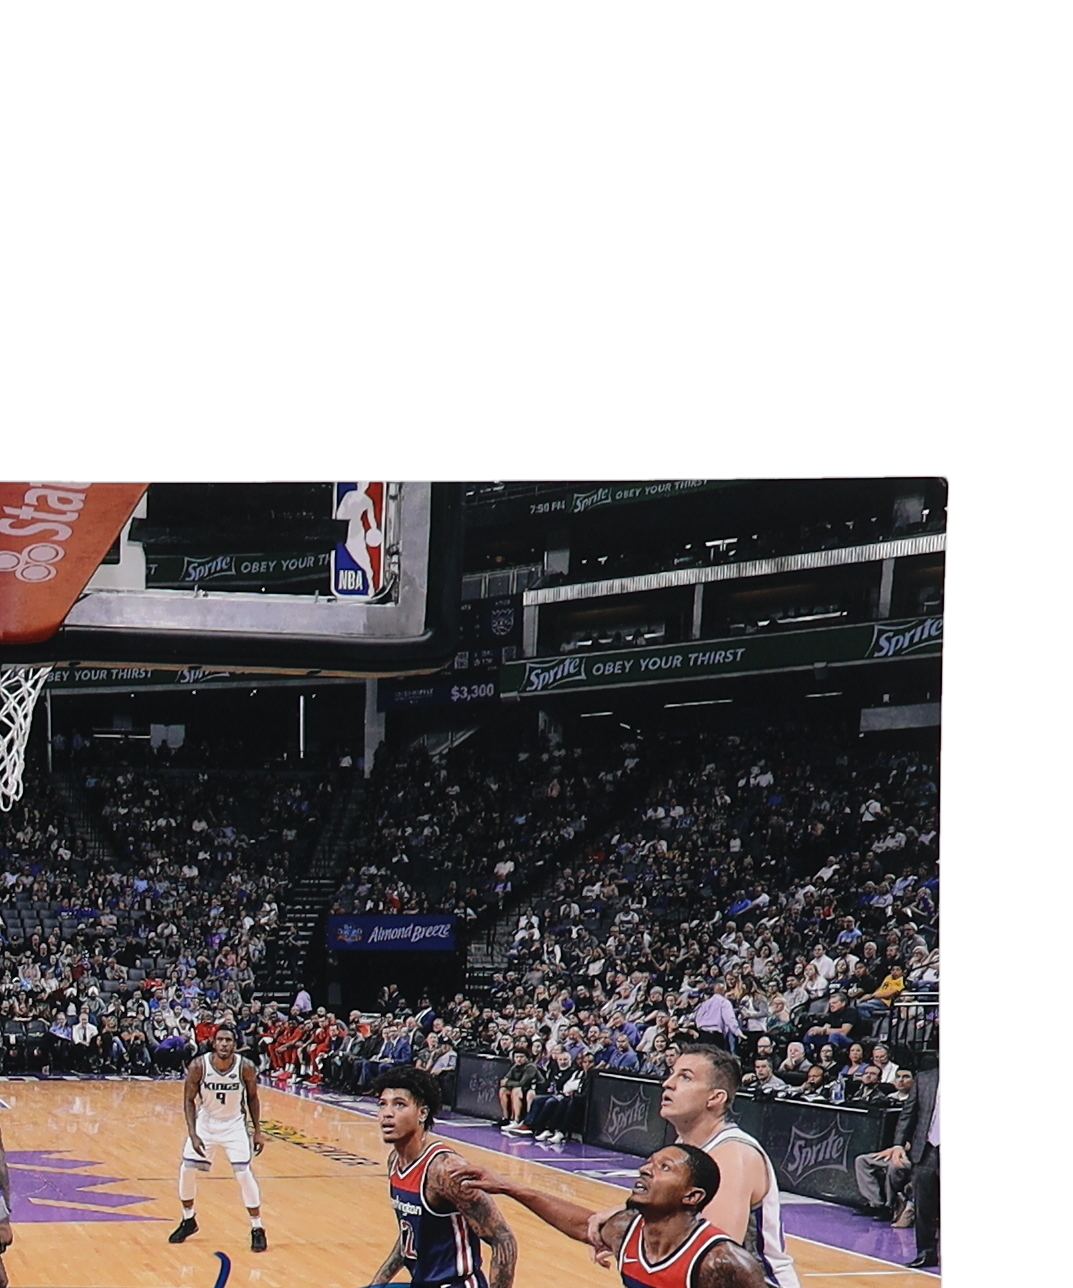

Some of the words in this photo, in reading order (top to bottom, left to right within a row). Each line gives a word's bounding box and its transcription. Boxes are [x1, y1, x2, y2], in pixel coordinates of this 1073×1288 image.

[615, 488, 641, 500] OBEY
[644, 482, 672, 496] YOUR
[184, 556, 231, 582] Sprite
[240, 560, 278, 574] OBEY
[280, 555, 316, 571] YOUR
[338, 569, 364, 591] NBA
[873, 618, 942, 657] Sprite
[46, 670, 70, 682] BEY
[73, 669, 109, 681] YOUR
[110, 667, 154, 680] THIRST
[525, 658, 581, 692] Sprite
[592, 659, 633, 676] OBEY
[638, 654, 683, 672] YOUR
[688, 648, 745, 666] THIRST
[450, 683, 495, 702] $3,300
[367, 923, 414, 943] Almond
[410, 923, 451, 942] Breeze
[203, 1082, 240, 1091] KINGS
[216, 1092, 226, 1105] 9
[608, 1102, 648, 1132] Sprite
[787, 1130, 844, 1171] Sprite
